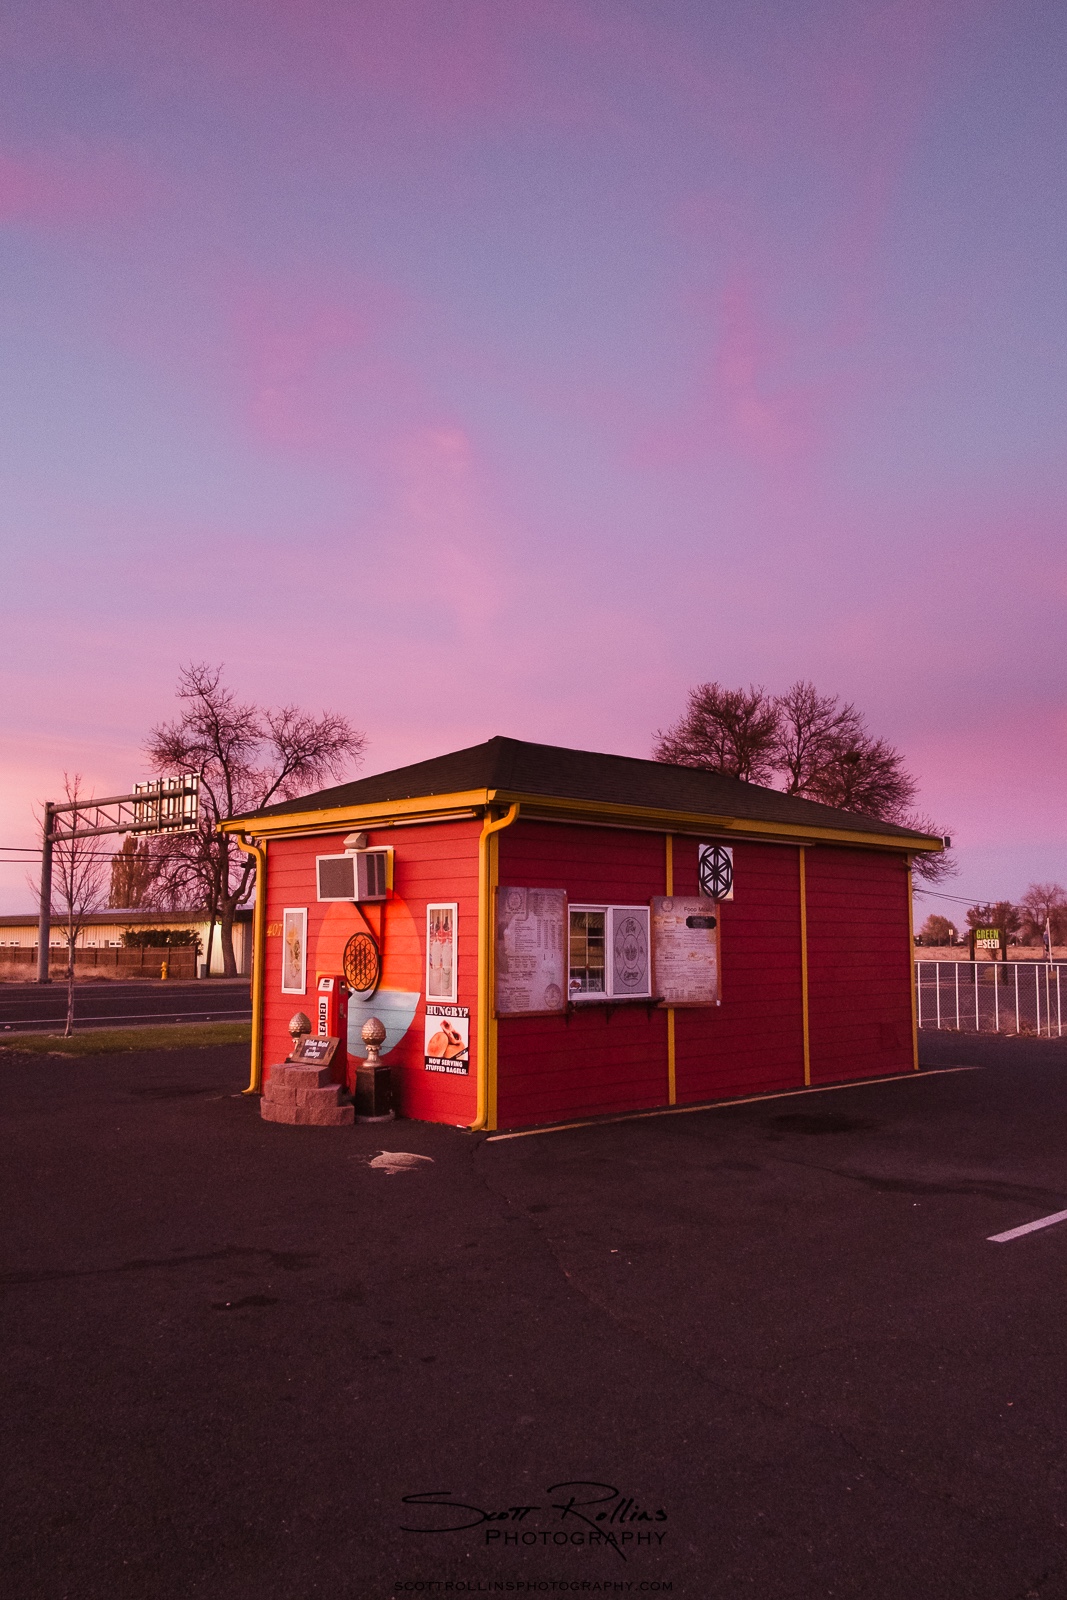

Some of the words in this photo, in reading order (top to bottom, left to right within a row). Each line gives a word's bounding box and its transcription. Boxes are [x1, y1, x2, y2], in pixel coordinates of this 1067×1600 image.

[976, 929, 999, 939] GREEN
[983, 938, 1000, 948] SEED
[426, 1004, 469, 1018] HUNGRY?
[425, 1064, 446, 1072] STUFFED
[442, 1059, 463, 1068] SERVING
